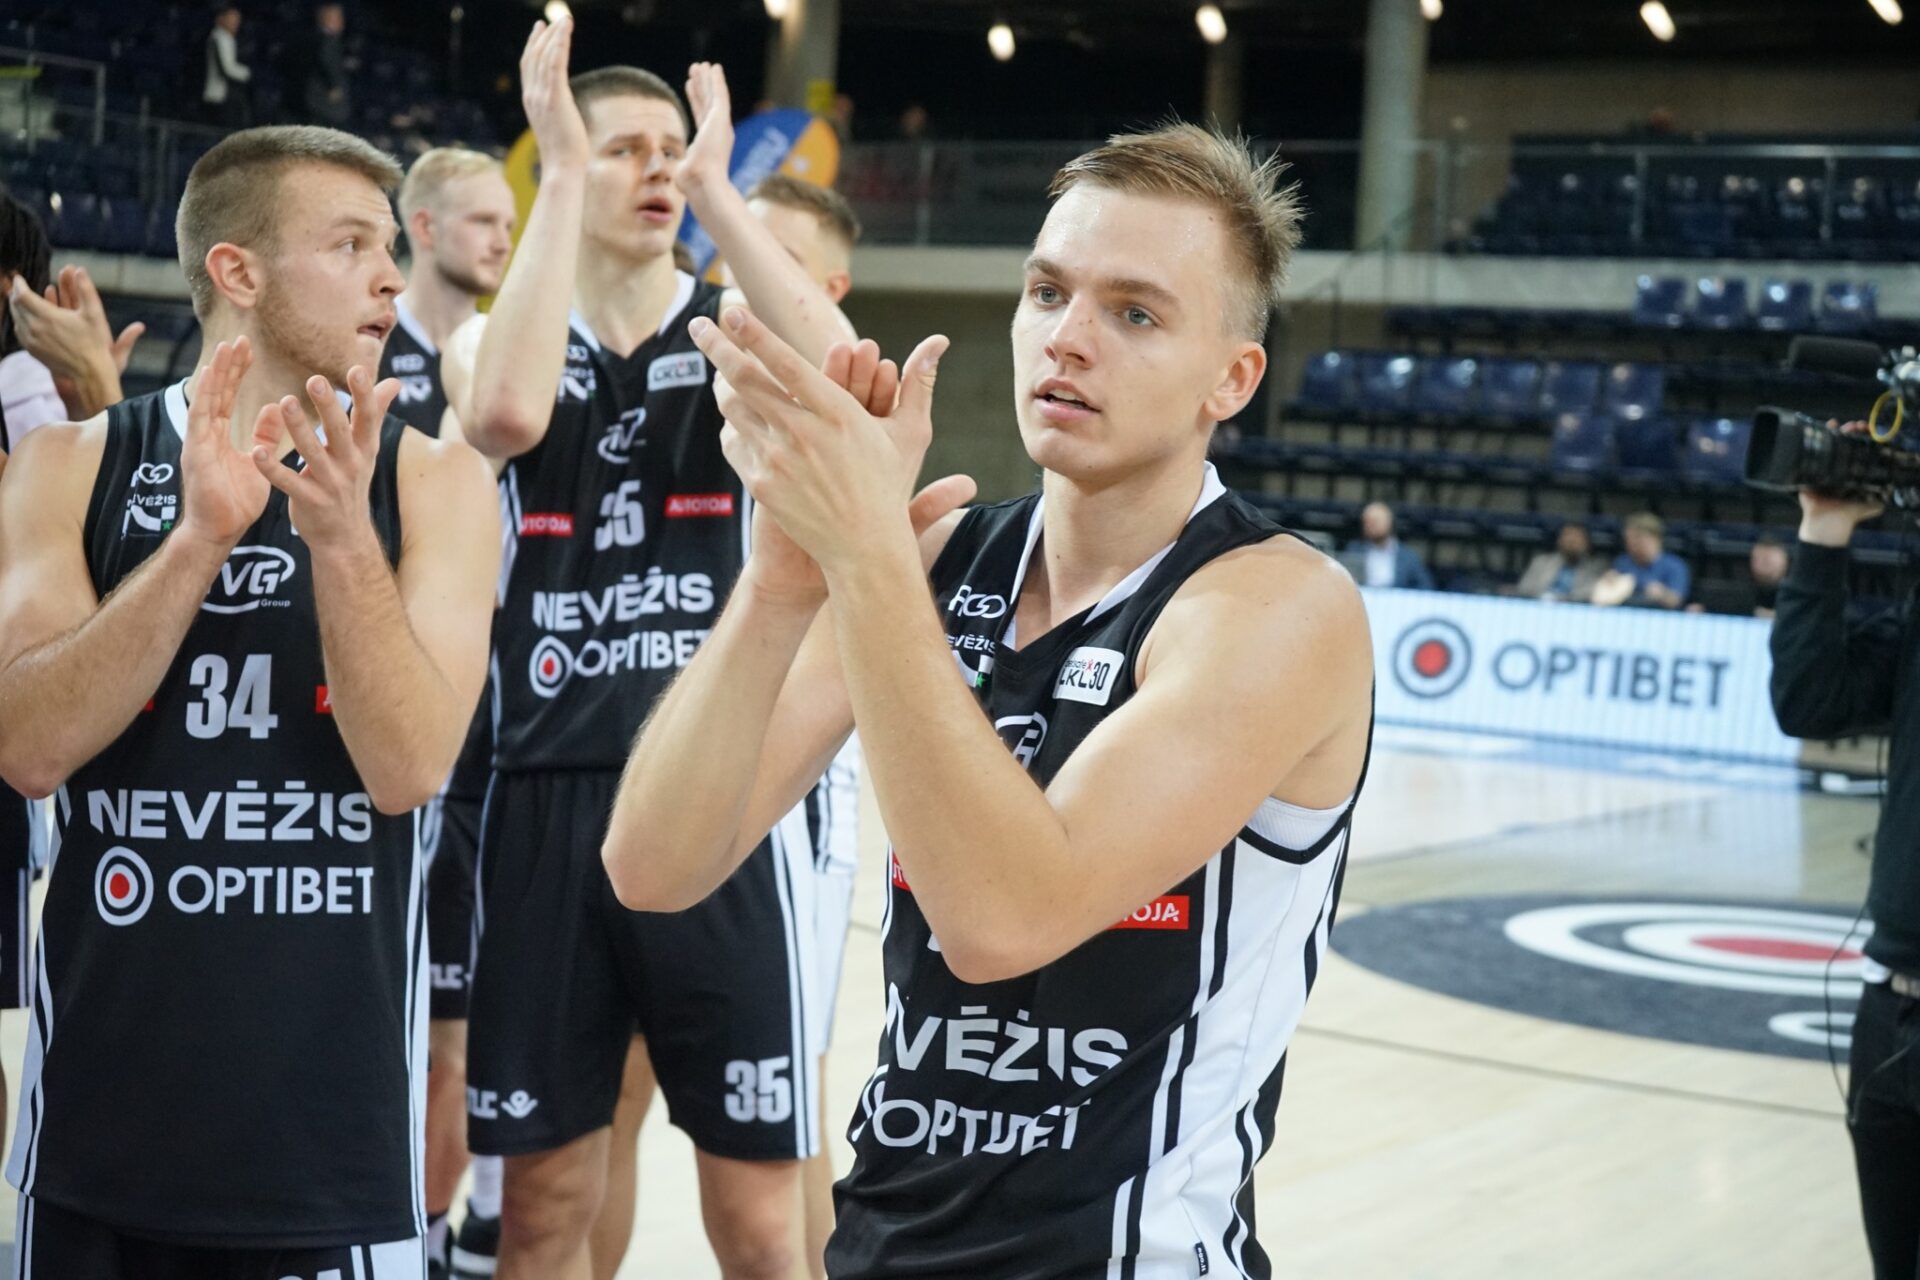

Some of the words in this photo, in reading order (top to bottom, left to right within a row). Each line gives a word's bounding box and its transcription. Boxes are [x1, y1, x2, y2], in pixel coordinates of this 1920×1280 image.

[261, 599, 291, 608] Group
[185, 653, 278, 739] 34
[1493, 642, 1730, 708] OPTIBET
[168, 865, 374, 914] OPTIBET
[724, 1056, 793, 1123] 35
